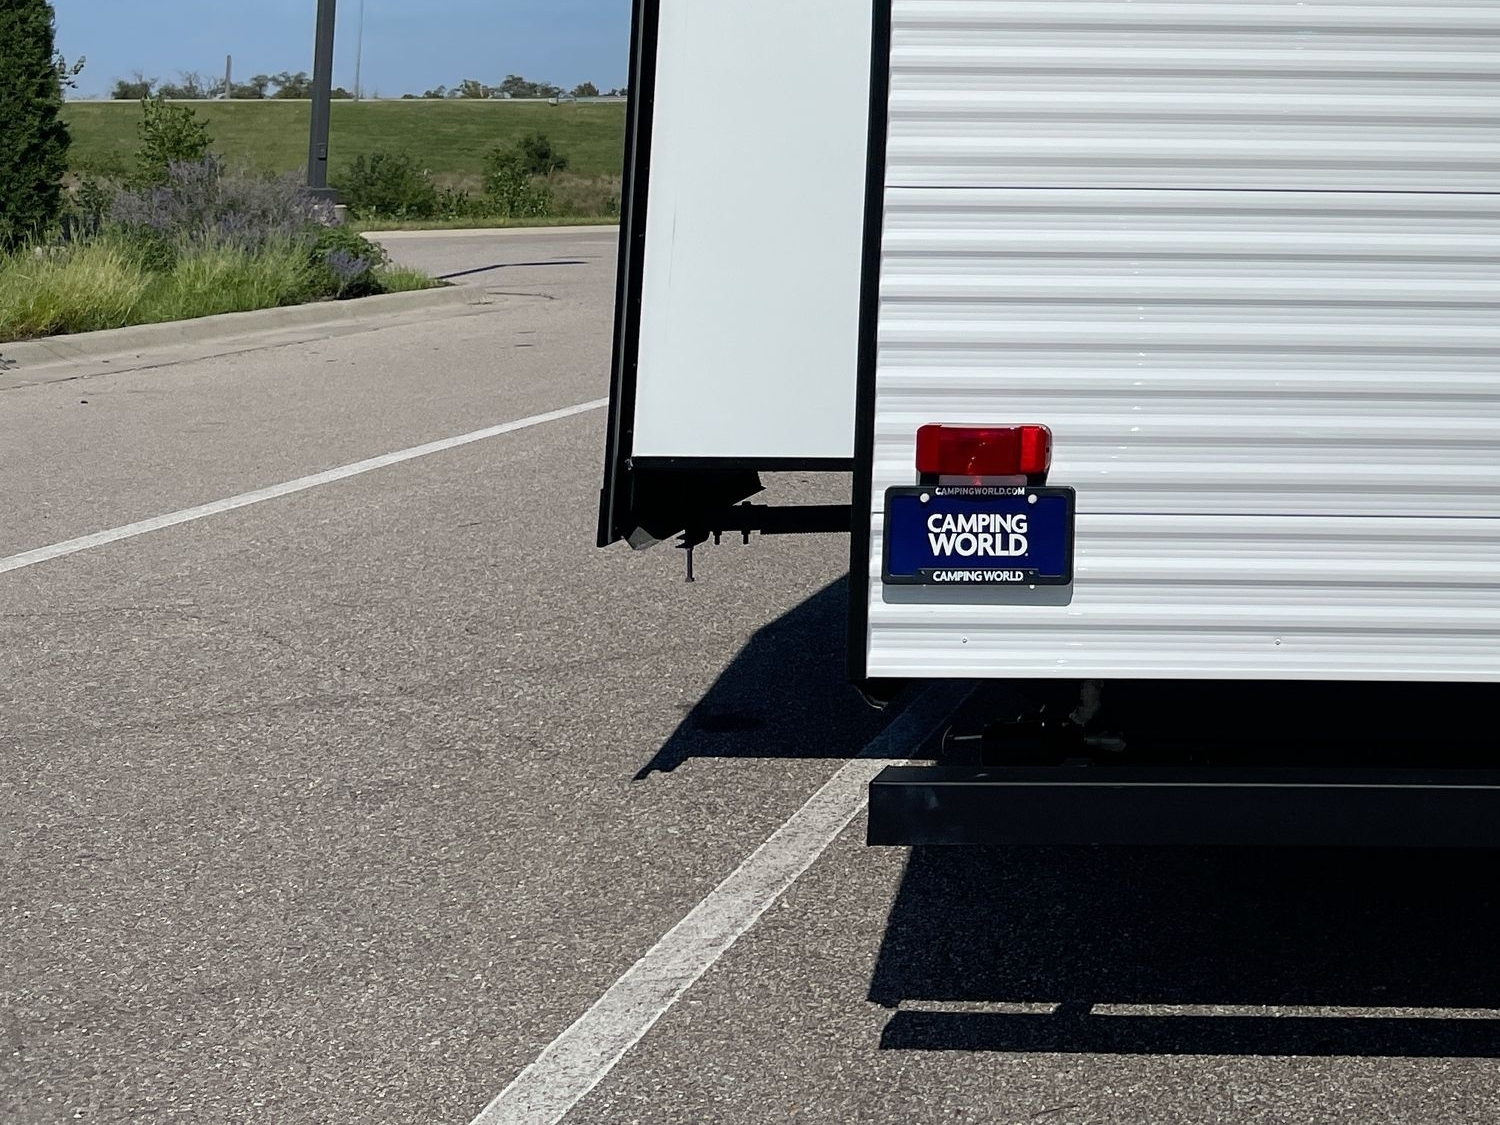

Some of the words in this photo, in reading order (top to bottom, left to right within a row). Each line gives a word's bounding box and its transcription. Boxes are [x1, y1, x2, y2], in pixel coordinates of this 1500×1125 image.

[935, 487, 1025, 496] CAMPINGWORLD.COM
[927, 514, 1028, 534] CAMPING
[927, 533, 1028, 556] WORLD
[932, 570, 982, 581] CAMPING
[983, 571, 1024, 581] WORLD
